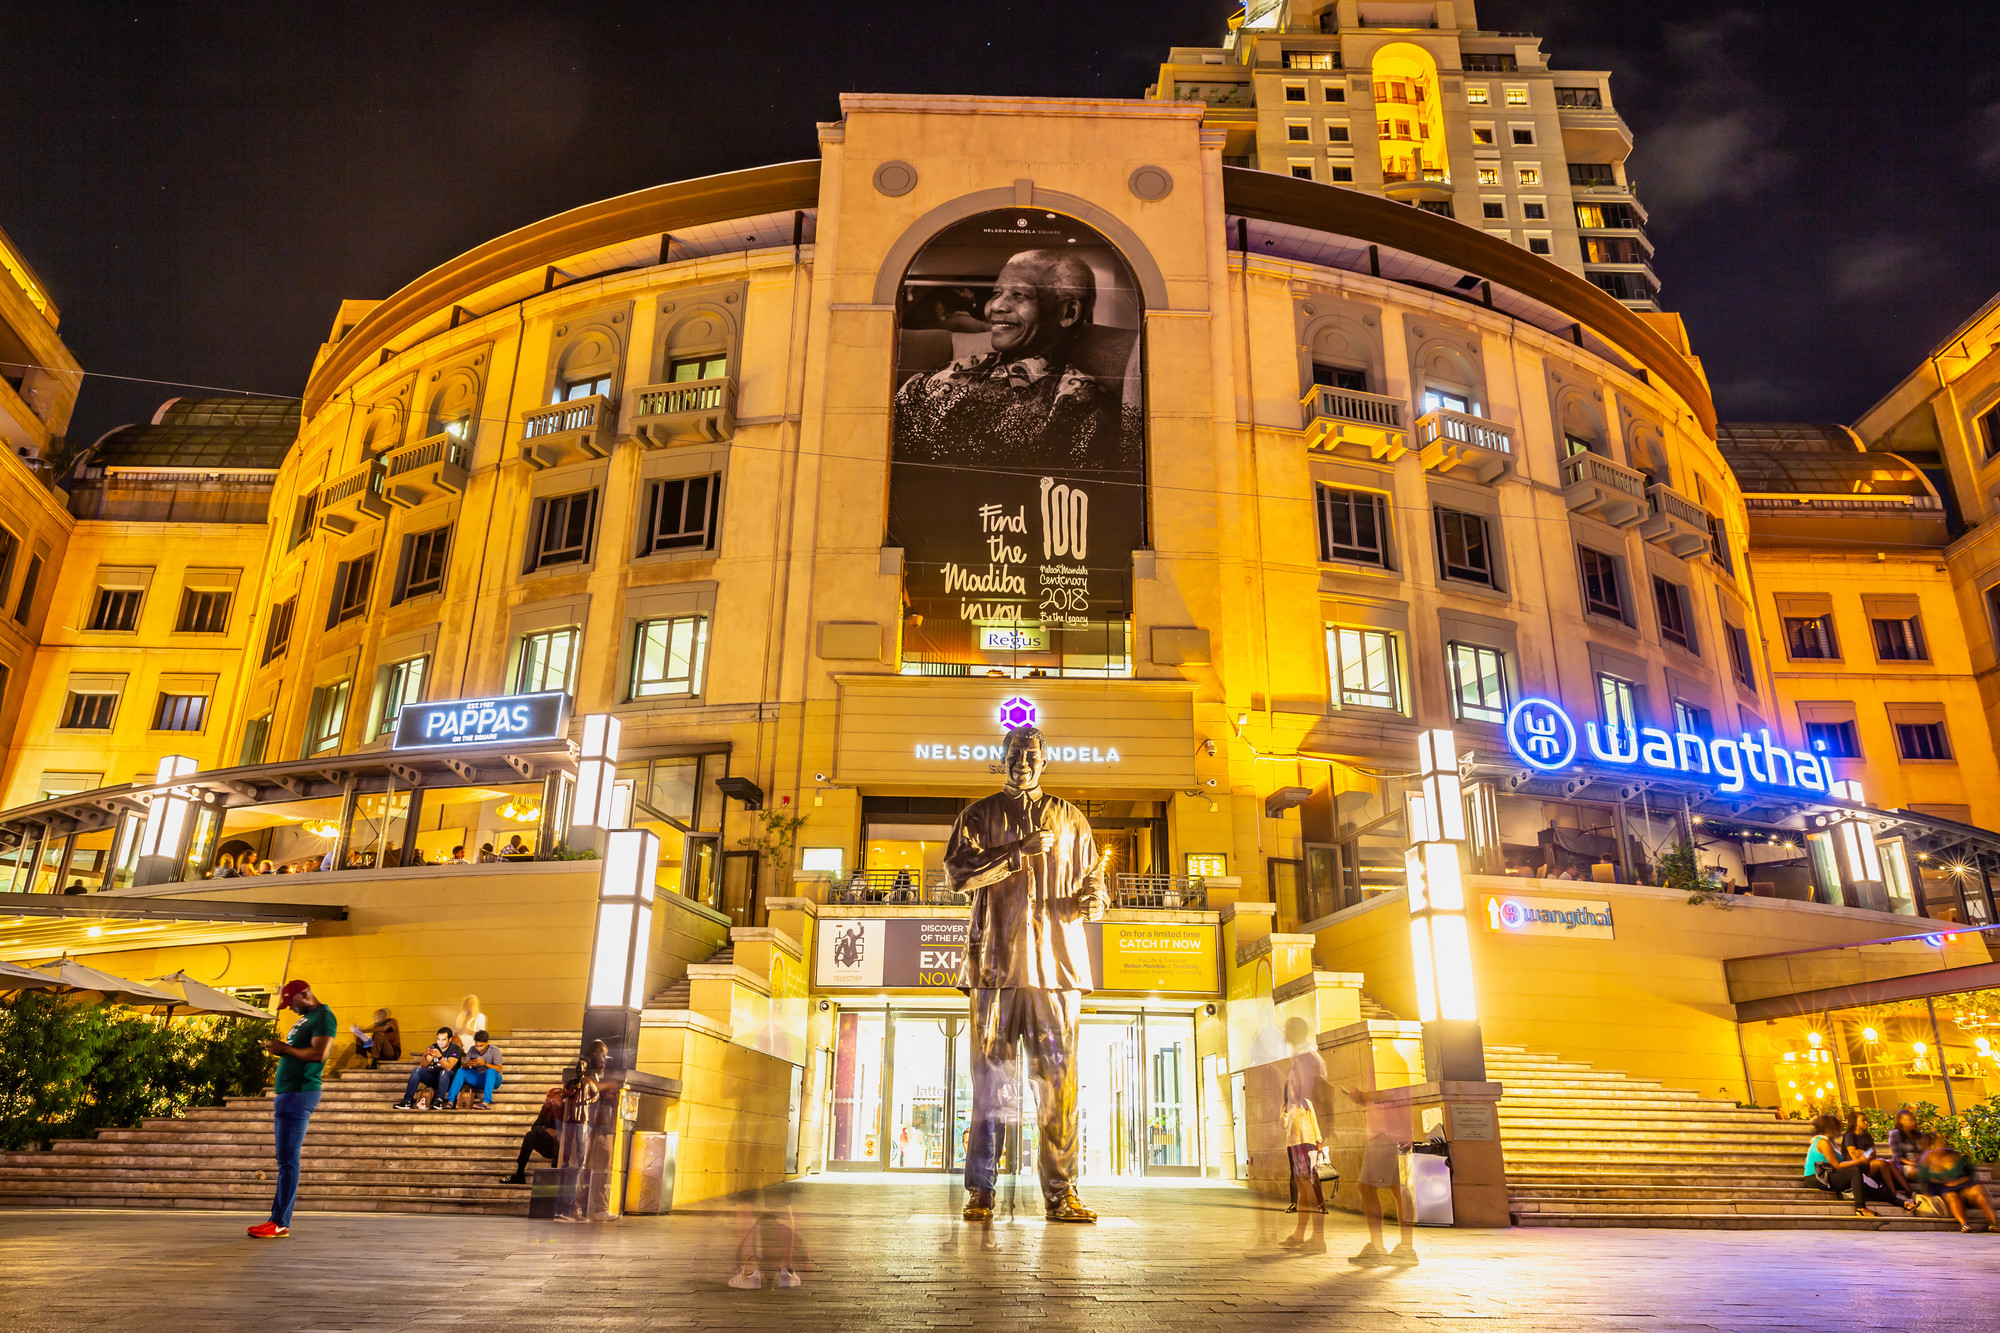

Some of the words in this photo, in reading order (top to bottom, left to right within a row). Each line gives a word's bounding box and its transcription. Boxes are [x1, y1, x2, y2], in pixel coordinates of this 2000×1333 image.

[978, 503, 1028, 534] Find
[986, 534, 1027, 564] the
[940, 562, 1026, 595] Madiba
[1040, 574, 1089, 593] Centenary
[1039, 587, 1089, 610] 2018
[960, 596, 984, 621] in
[986, 603, 1025, 628] you
[1052, 611, 1064, 622] the
[988, 632, 1041, 649] Regus
[426, 705, 529, 738] PAPPAS
[914, 744, 1003, 761] NELSON
[1046, 746, 1121, 762] NDELA
[1585, 721, 1835, 797] wangthai
[1523, 906, 1613, 929] wangthai
[921, 924, 964, 932] DISCOVER
[1119, 929, 1132, 938] On
[1133, 929, 1145, 938] for
[1153, 930, 1181, 938] limited
[1183, 930, 1201, 939] time
[921, 934, 933, 942] OF
[935, 934, 951, 942] THE
[1119, 939, 1157, 949] CATCH
[1160, 939, 1170, 949] IT
[1172, 940, 1201, 949] NOW
[919, 971, 959, 986] NOW
[916, 1085, 944, 1096] latte
